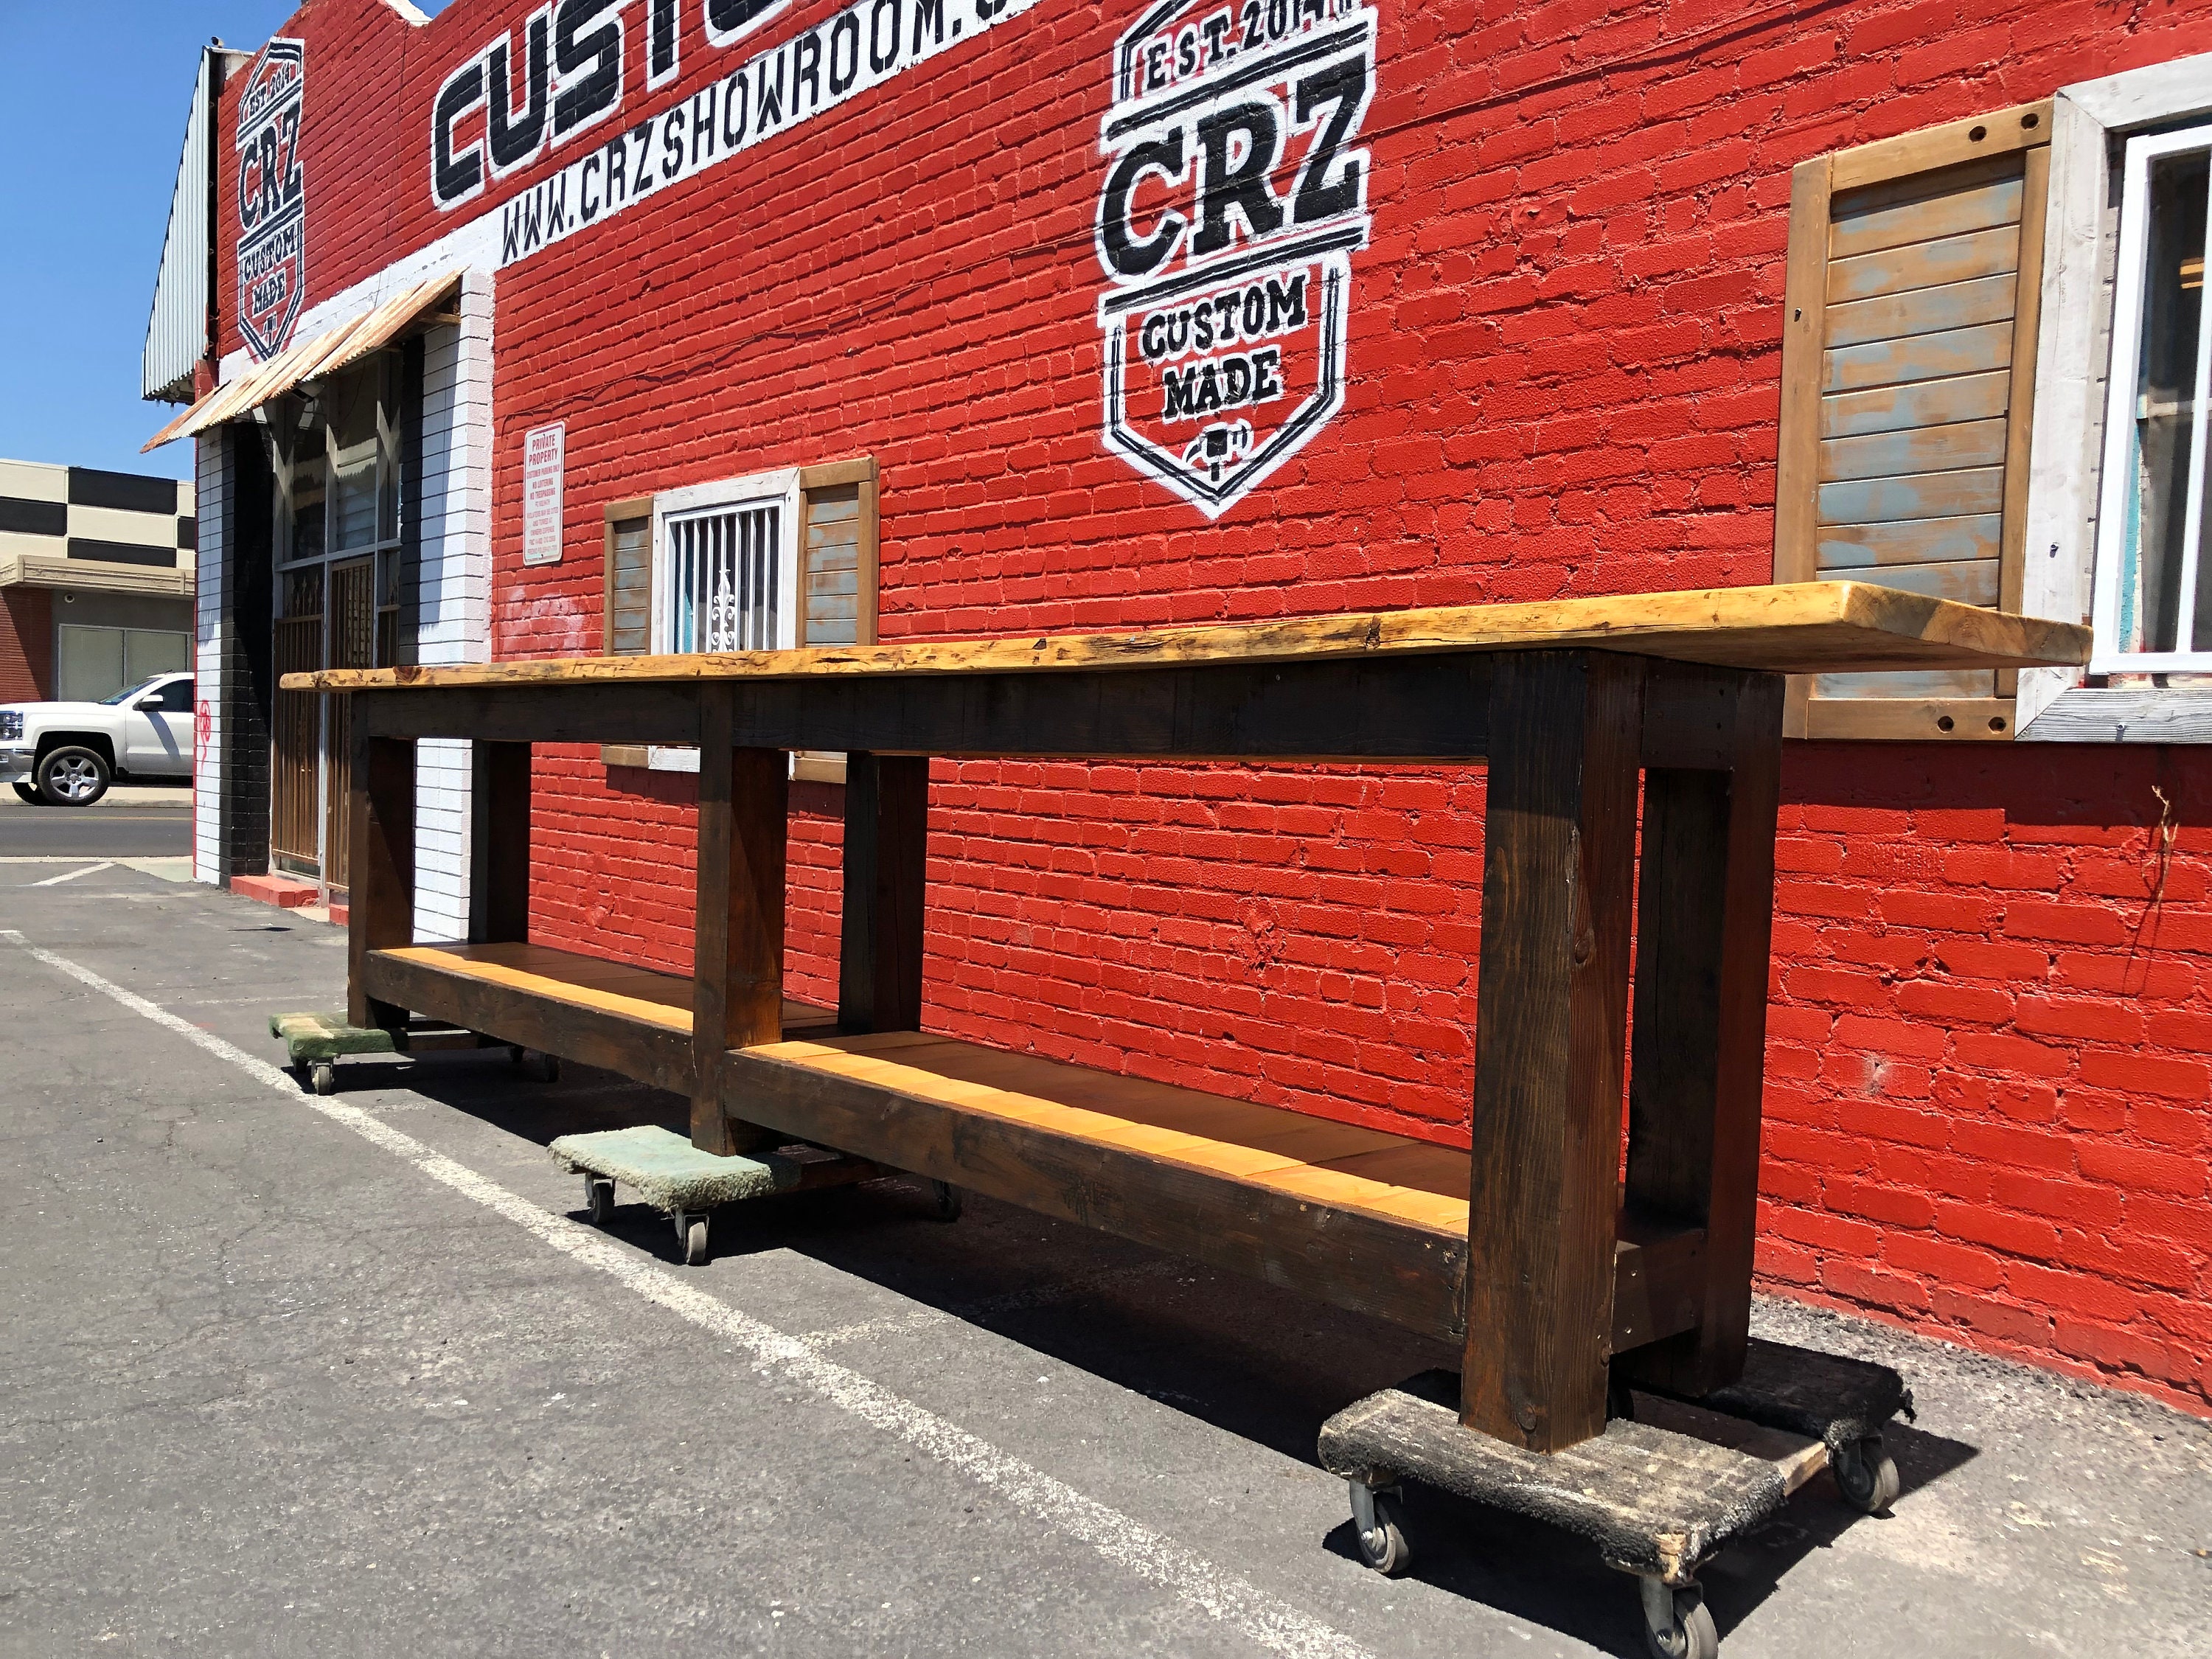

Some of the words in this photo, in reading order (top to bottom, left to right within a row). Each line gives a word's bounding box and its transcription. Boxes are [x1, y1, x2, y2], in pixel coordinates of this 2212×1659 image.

[237, 102, 302, 224] CRZ
[501, 0, 1009, 265] WWW.CRZSHOWROOM.
[1103, 52, 1367, 274] CRZ
[244, 226, 296, 282] CUSTOM
[253, 273, 286, 315] MADE
[1142, 274, 1306, 359] CUSTOM
[1164, 349, 1279, 419] MADE
[529, 448, 558, 467] PROPERTY
[532, 434, 555, 453] PRIVATE
